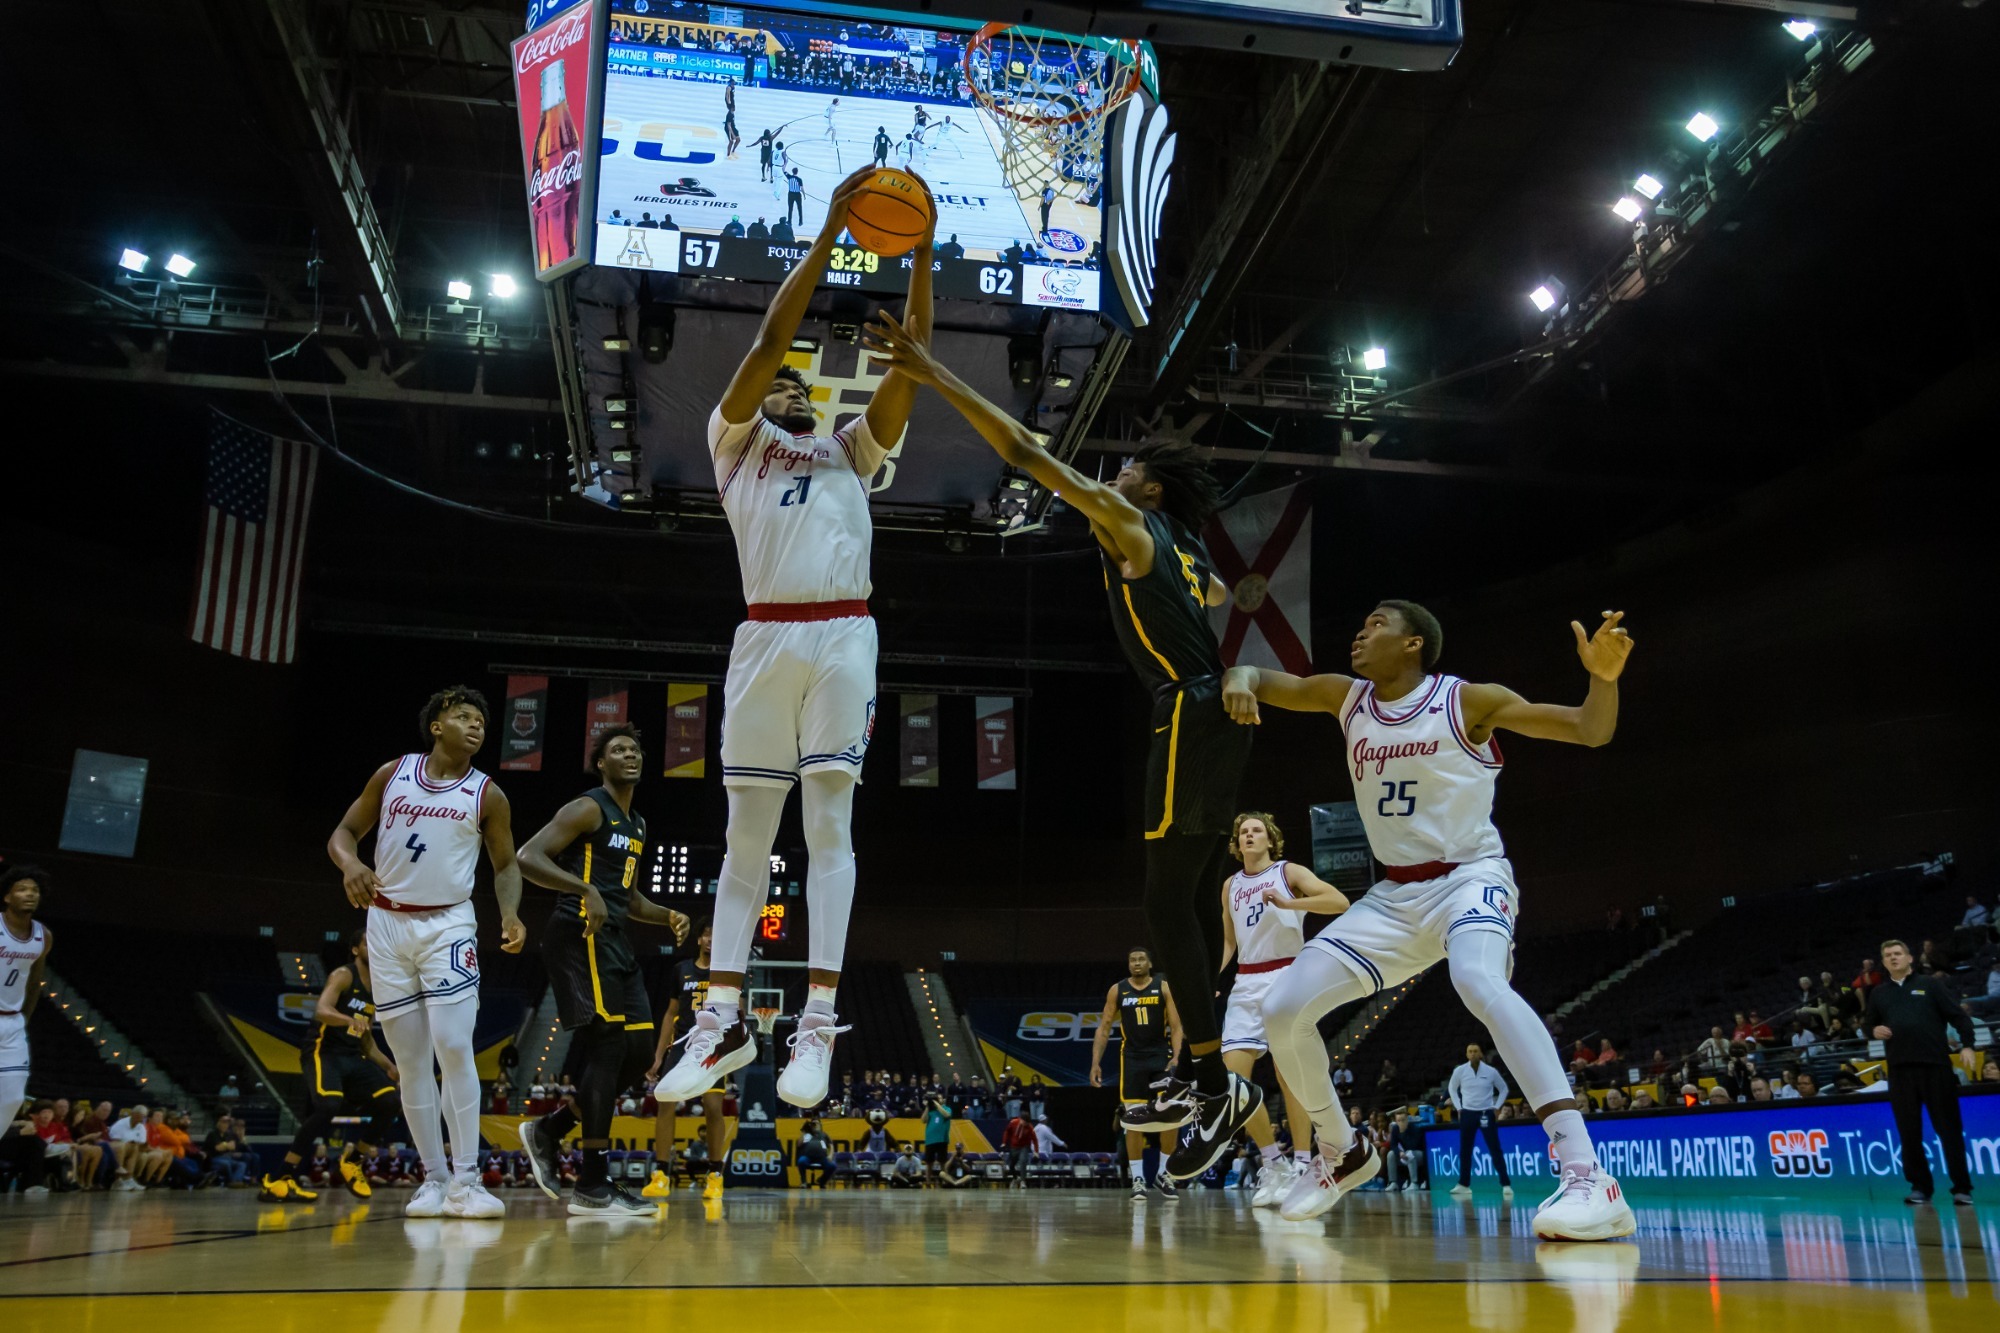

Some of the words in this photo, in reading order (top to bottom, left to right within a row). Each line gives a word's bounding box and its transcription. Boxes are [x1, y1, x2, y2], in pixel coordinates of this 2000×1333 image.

[519, 7, 589, 74] Coca-Cola
[611, 19, 739, 47] ONFERENC
[608, 48, 648, 61] PARTNER
[681, 54, 763, 73] TicketSmarr
[530, 149, 583, 206] Coca-Cola
[633, 195, 700, 206] HERCULES
[701, 200, 739, 209] TIRES
[931, 193, 989, 206] BELT
[617, 228, 654, 268] A
[685, 238, 720, 268] 57
[767, 246, 809, 260] FOULS
[830, 247, 879, 274] 3:29
[783, 261, 791, 271] 3
[827, 271, 852, 285] HALF
[853, 273, 861, 286] 2
[900, 258, 942, 272] FOS
[979, 266, 1014, 295] 62
[758, 440, 830, 480] Jagurs
[1353, 737, 1440, 782] Jaguars
[1377, 780, 1418, 817] 25
[386, 795, 468, 830] Jaguars
[405, 833, 427, 863] 4
[607, 832, 643, 856] APPSTA
[771, 860, 786, 873] 57
[1234, 880, 1276, 912] Jaguars
[763, 917, 782, 940] 12
[4, 968, 20, 987] 0
[1121, 996, 1160, 1007] APPSTATE
[1134, 1006, 1149, 1026] 11
[731, 1149, 782, 1176] SBC
[1430, 1143, 1542, 1177] TickSmrter
[1597, 1139, 1668, 1178] OFFICIAL
[1670, 1135, 1758, 1177] PARTNER
[1768, 1128, 1833, 1178] SBC
